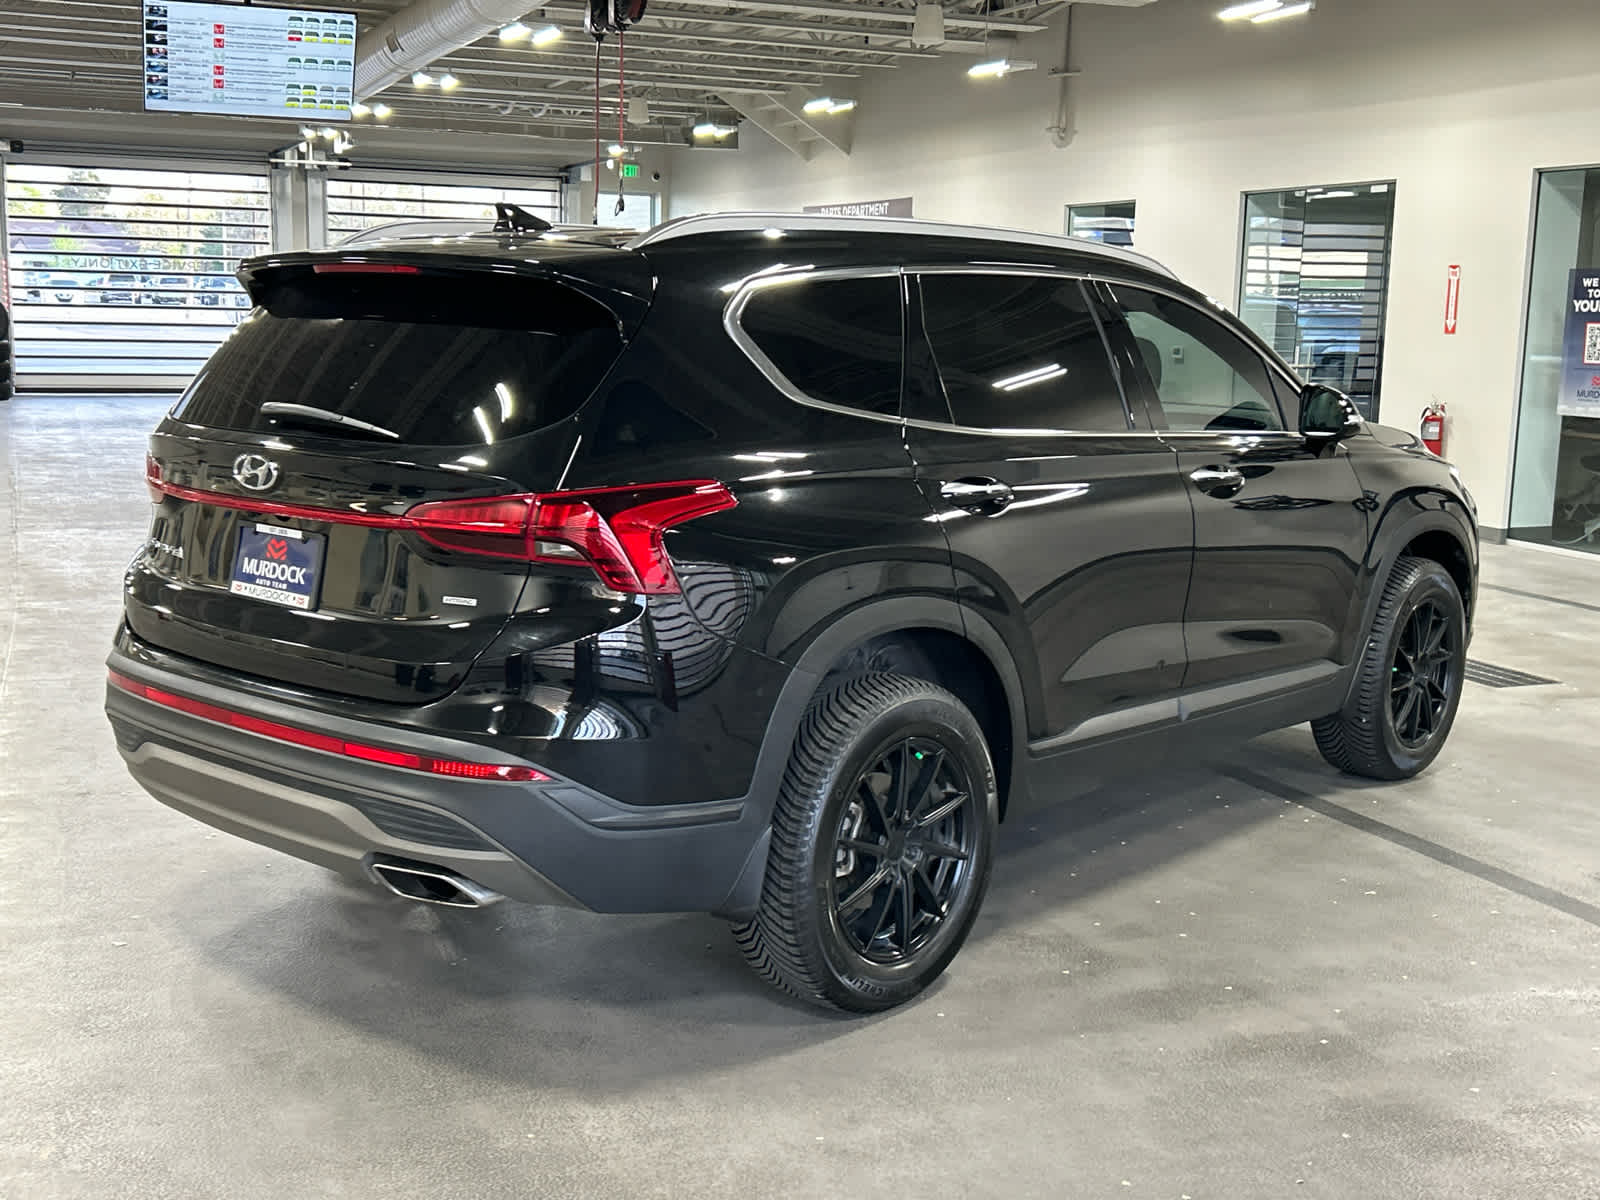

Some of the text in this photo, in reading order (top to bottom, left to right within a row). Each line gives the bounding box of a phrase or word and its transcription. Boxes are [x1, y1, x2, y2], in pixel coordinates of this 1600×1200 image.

[842, 202, 889, 217] DEPARTMENT
[1582, 277, 1599, 288] WE
[1573, 299, 1600, 313] YOU
[1577, 389, 1600, 399] MURD
[242, 557, 306, 584] MURDOCK
[255, 578, 287, 589] AUTO TEAM
[248, 587, 291, 602] MURDOCK
